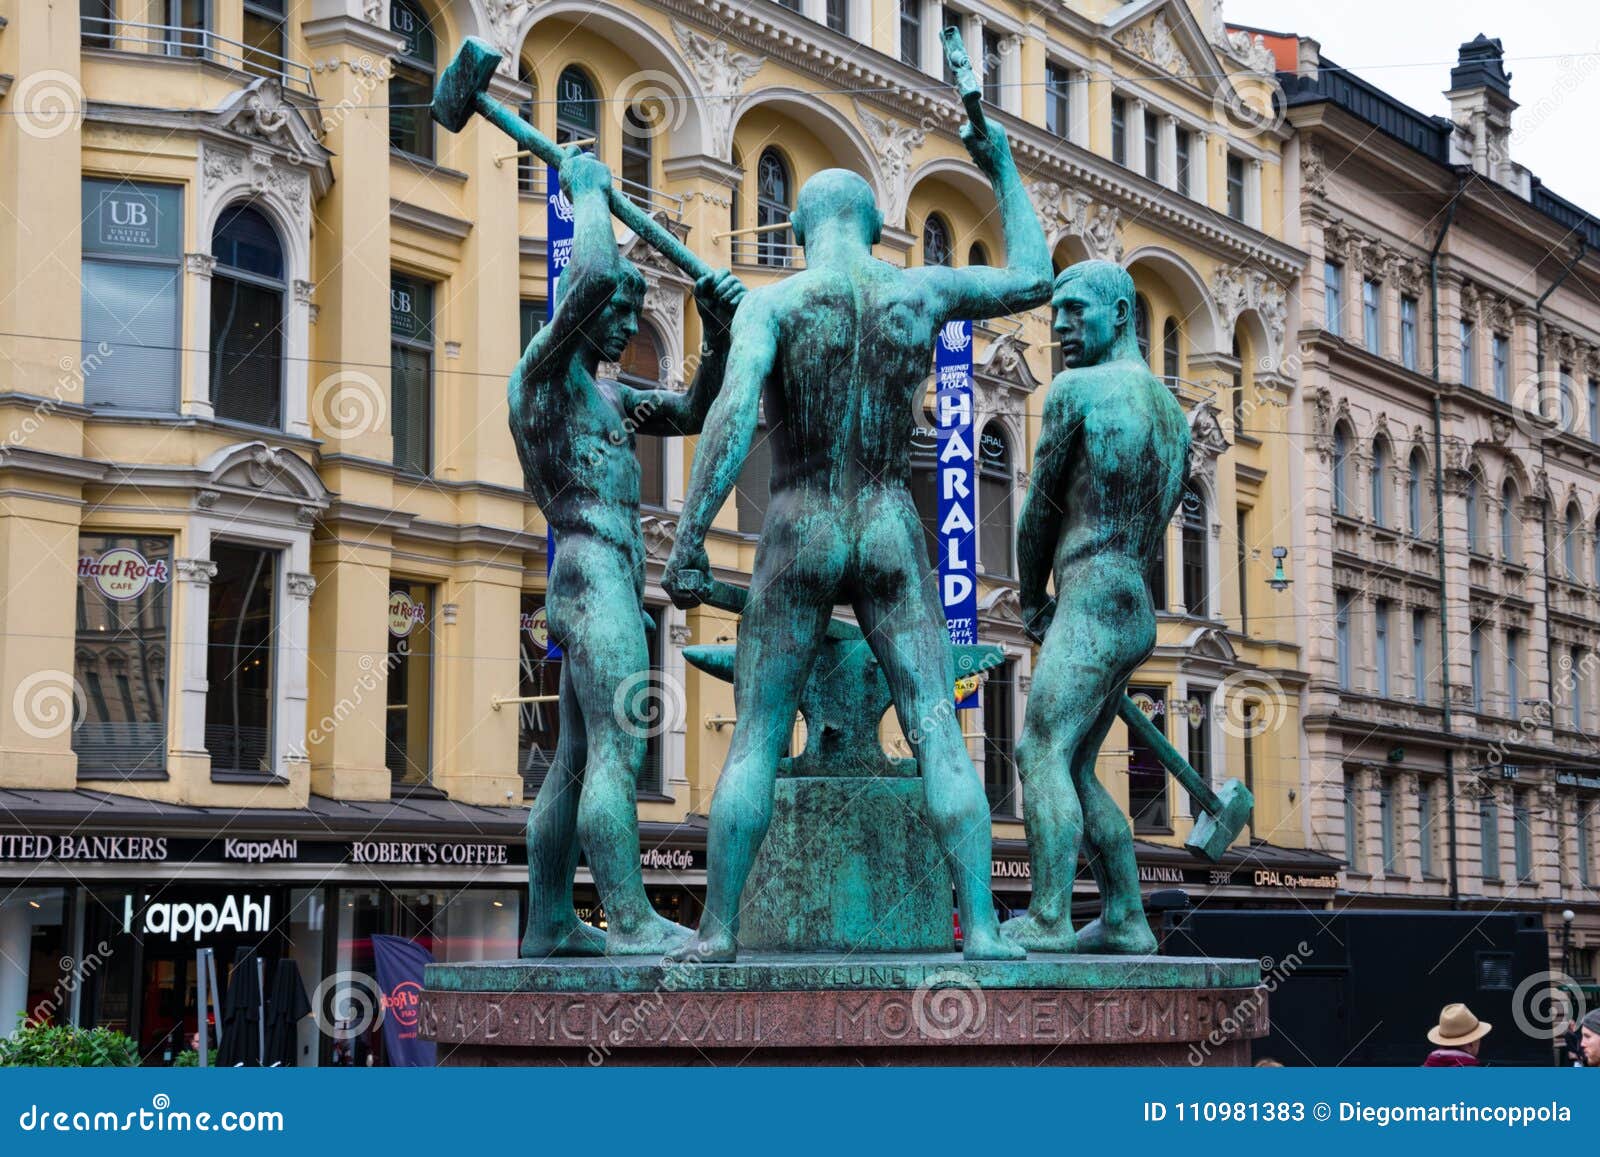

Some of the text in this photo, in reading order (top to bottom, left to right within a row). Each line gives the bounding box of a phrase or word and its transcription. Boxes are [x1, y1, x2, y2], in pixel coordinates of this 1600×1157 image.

[110, 200, 148, 226] UB
[107, 234, 151, 244] BANKERS
[110, 228, 147, 237] UNITED
[391, 290, 411, 313] UB
[942, 378, 969, 390] TOLA
[940, 393, 973, 607] HARALD
[78, 558, 167, 581] Hard Rock
[60, 836, 168, 861] BANKERS
[225, 838, 298, 863] KappAhl
[352, 841, 508, 865] ROBERT'S COFFEE
[651, 849, 672, 868] Rock
[673, 850, 693, 869] Cafe
[992, 861, 1030, 877] LTAJOUS
[1254, 871, 1283, 886] ORAL
